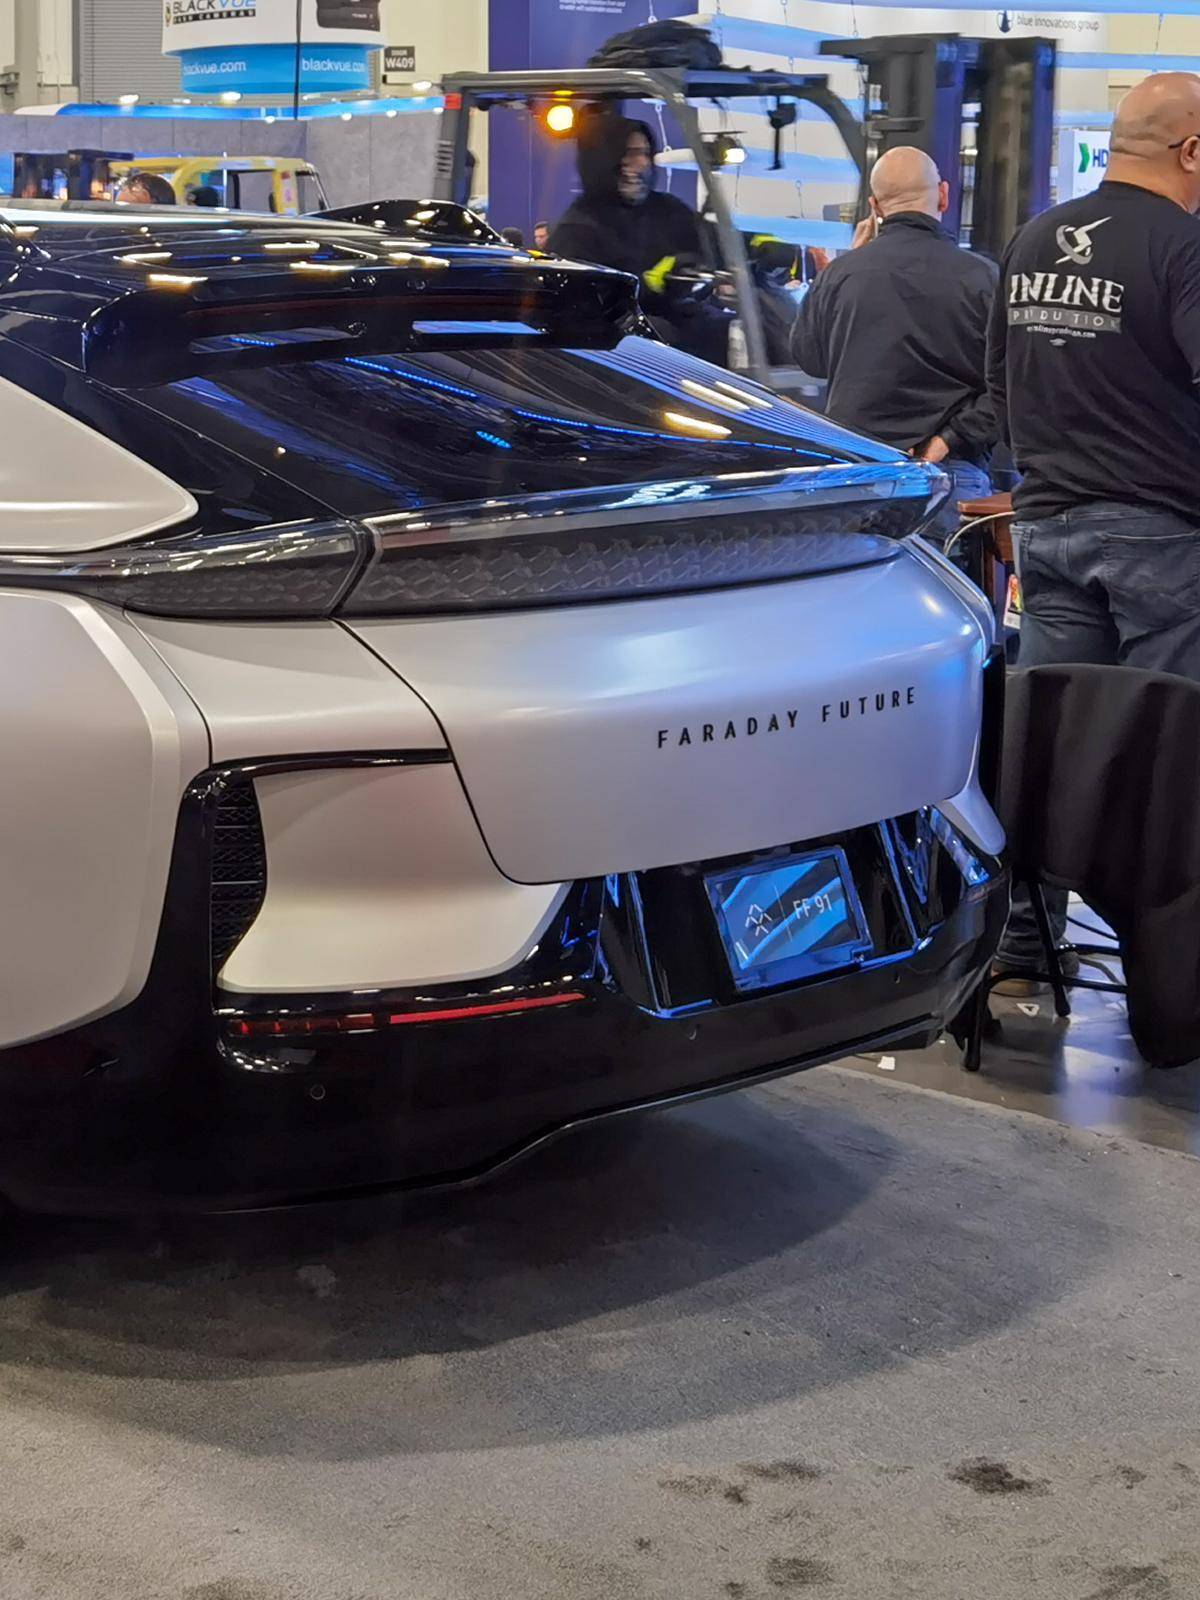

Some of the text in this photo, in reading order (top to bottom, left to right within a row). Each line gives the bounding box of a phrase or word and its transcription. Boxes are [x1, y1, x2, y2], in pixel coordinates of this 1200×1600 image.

[1017, 15, 1100, 32] blue innovations group
[302, 58, 366, 73] blackvue.com
[385, 57, 414, 69] W409
[1009, 272, 1124, 312] INLINE
[657, 686, 915, 749] FARADAY FUTURE
[792, 893, 833, 920] FF 91
